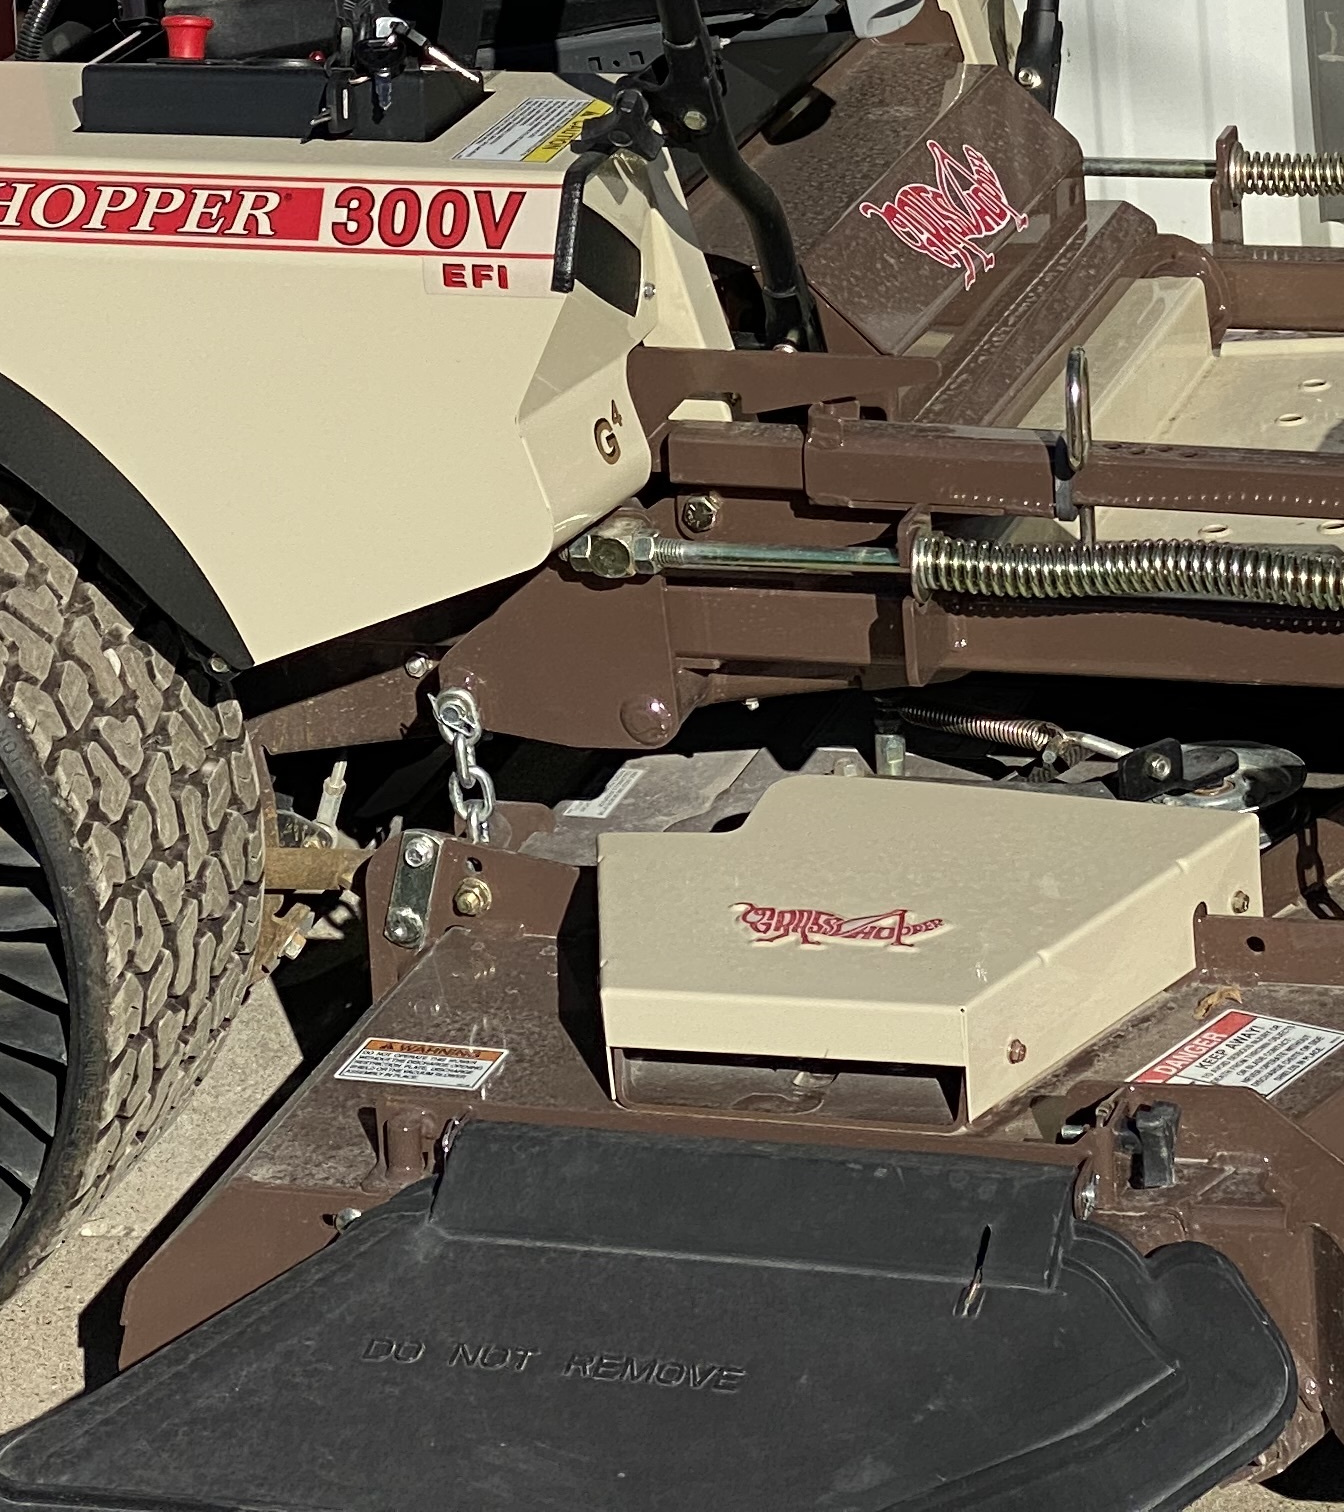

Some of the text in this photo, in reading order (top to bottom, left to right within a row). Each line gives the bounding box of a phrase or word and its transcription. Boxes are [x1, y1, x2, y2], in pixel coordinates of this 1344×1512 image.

[331, 185, 528, 251] 300V
[442, 262, 510, 290] EFI
[397, 1043, 484, 1058] WARNING
[1151, 1030, 1229, 1075] DANGER
[1193, 1024, 1266, 1069] KEEP AWAY!
[361, 1336, 748, 1393] DO NOT REMOVE
